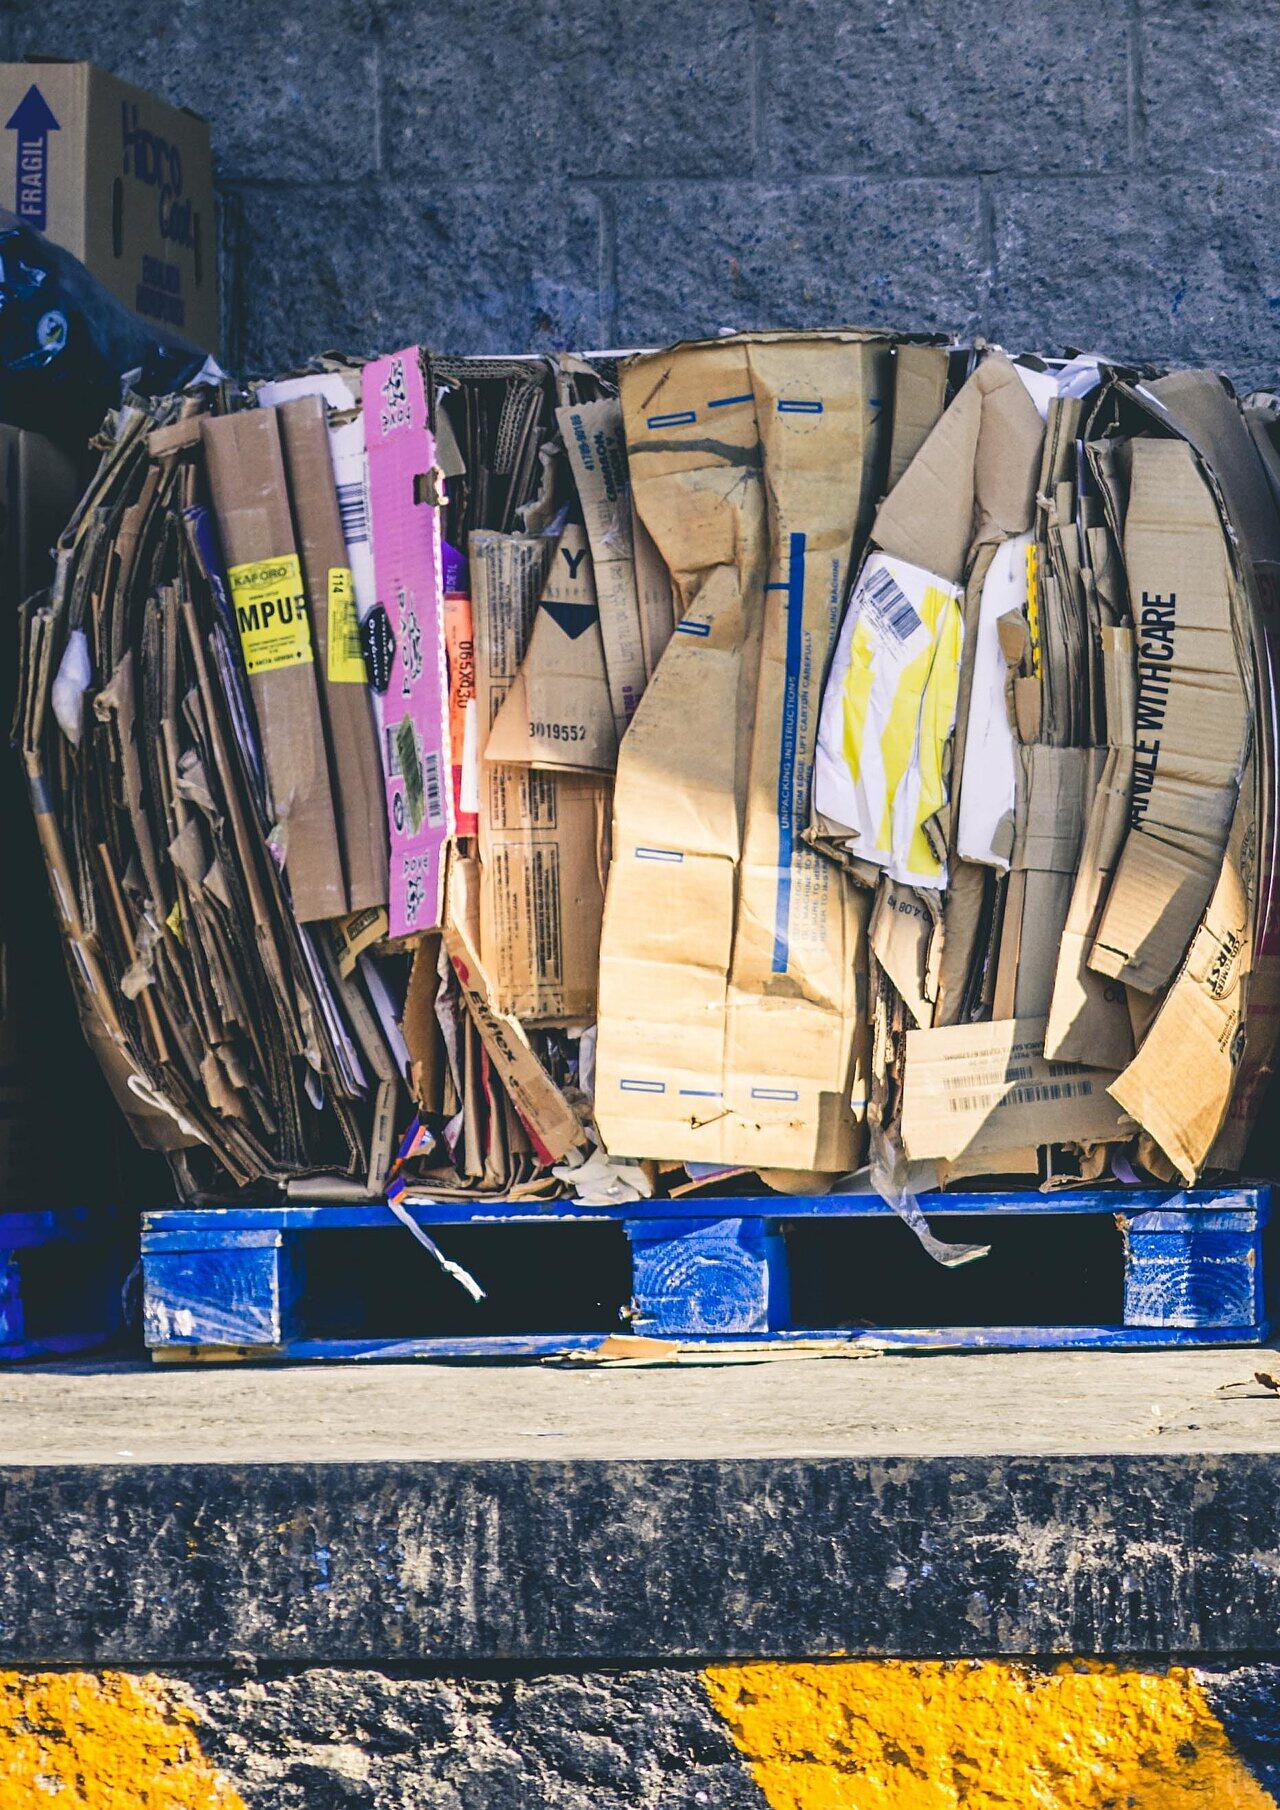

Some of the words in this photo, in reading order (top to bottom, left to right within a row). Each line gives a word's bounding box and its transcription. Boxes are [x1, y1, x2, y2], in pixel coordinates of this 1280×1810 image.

[20, 137, 43, 216] FRAGIL
[561, 548, 587, 580] Y
[831, 558, 840, 604] MACHINE
[1140, 591, 1176, 661] CARE
[802, 631, 812, 688] CAREFULLY
[784, 676, 796, 760] INSTRUCTIONS
[800, 689, 810, 732] CARTON
[1136, 662, 1172, 729] WITH
[781, 763, 792, 829] UNPACKING
[1130, 740, 1161, 830] ANDLE
[899, 902, 921, 916] 4.08
[1206, 930, 1236, 993] FIRST
[1215, 940, 1240, 998] CUSTOMERS
